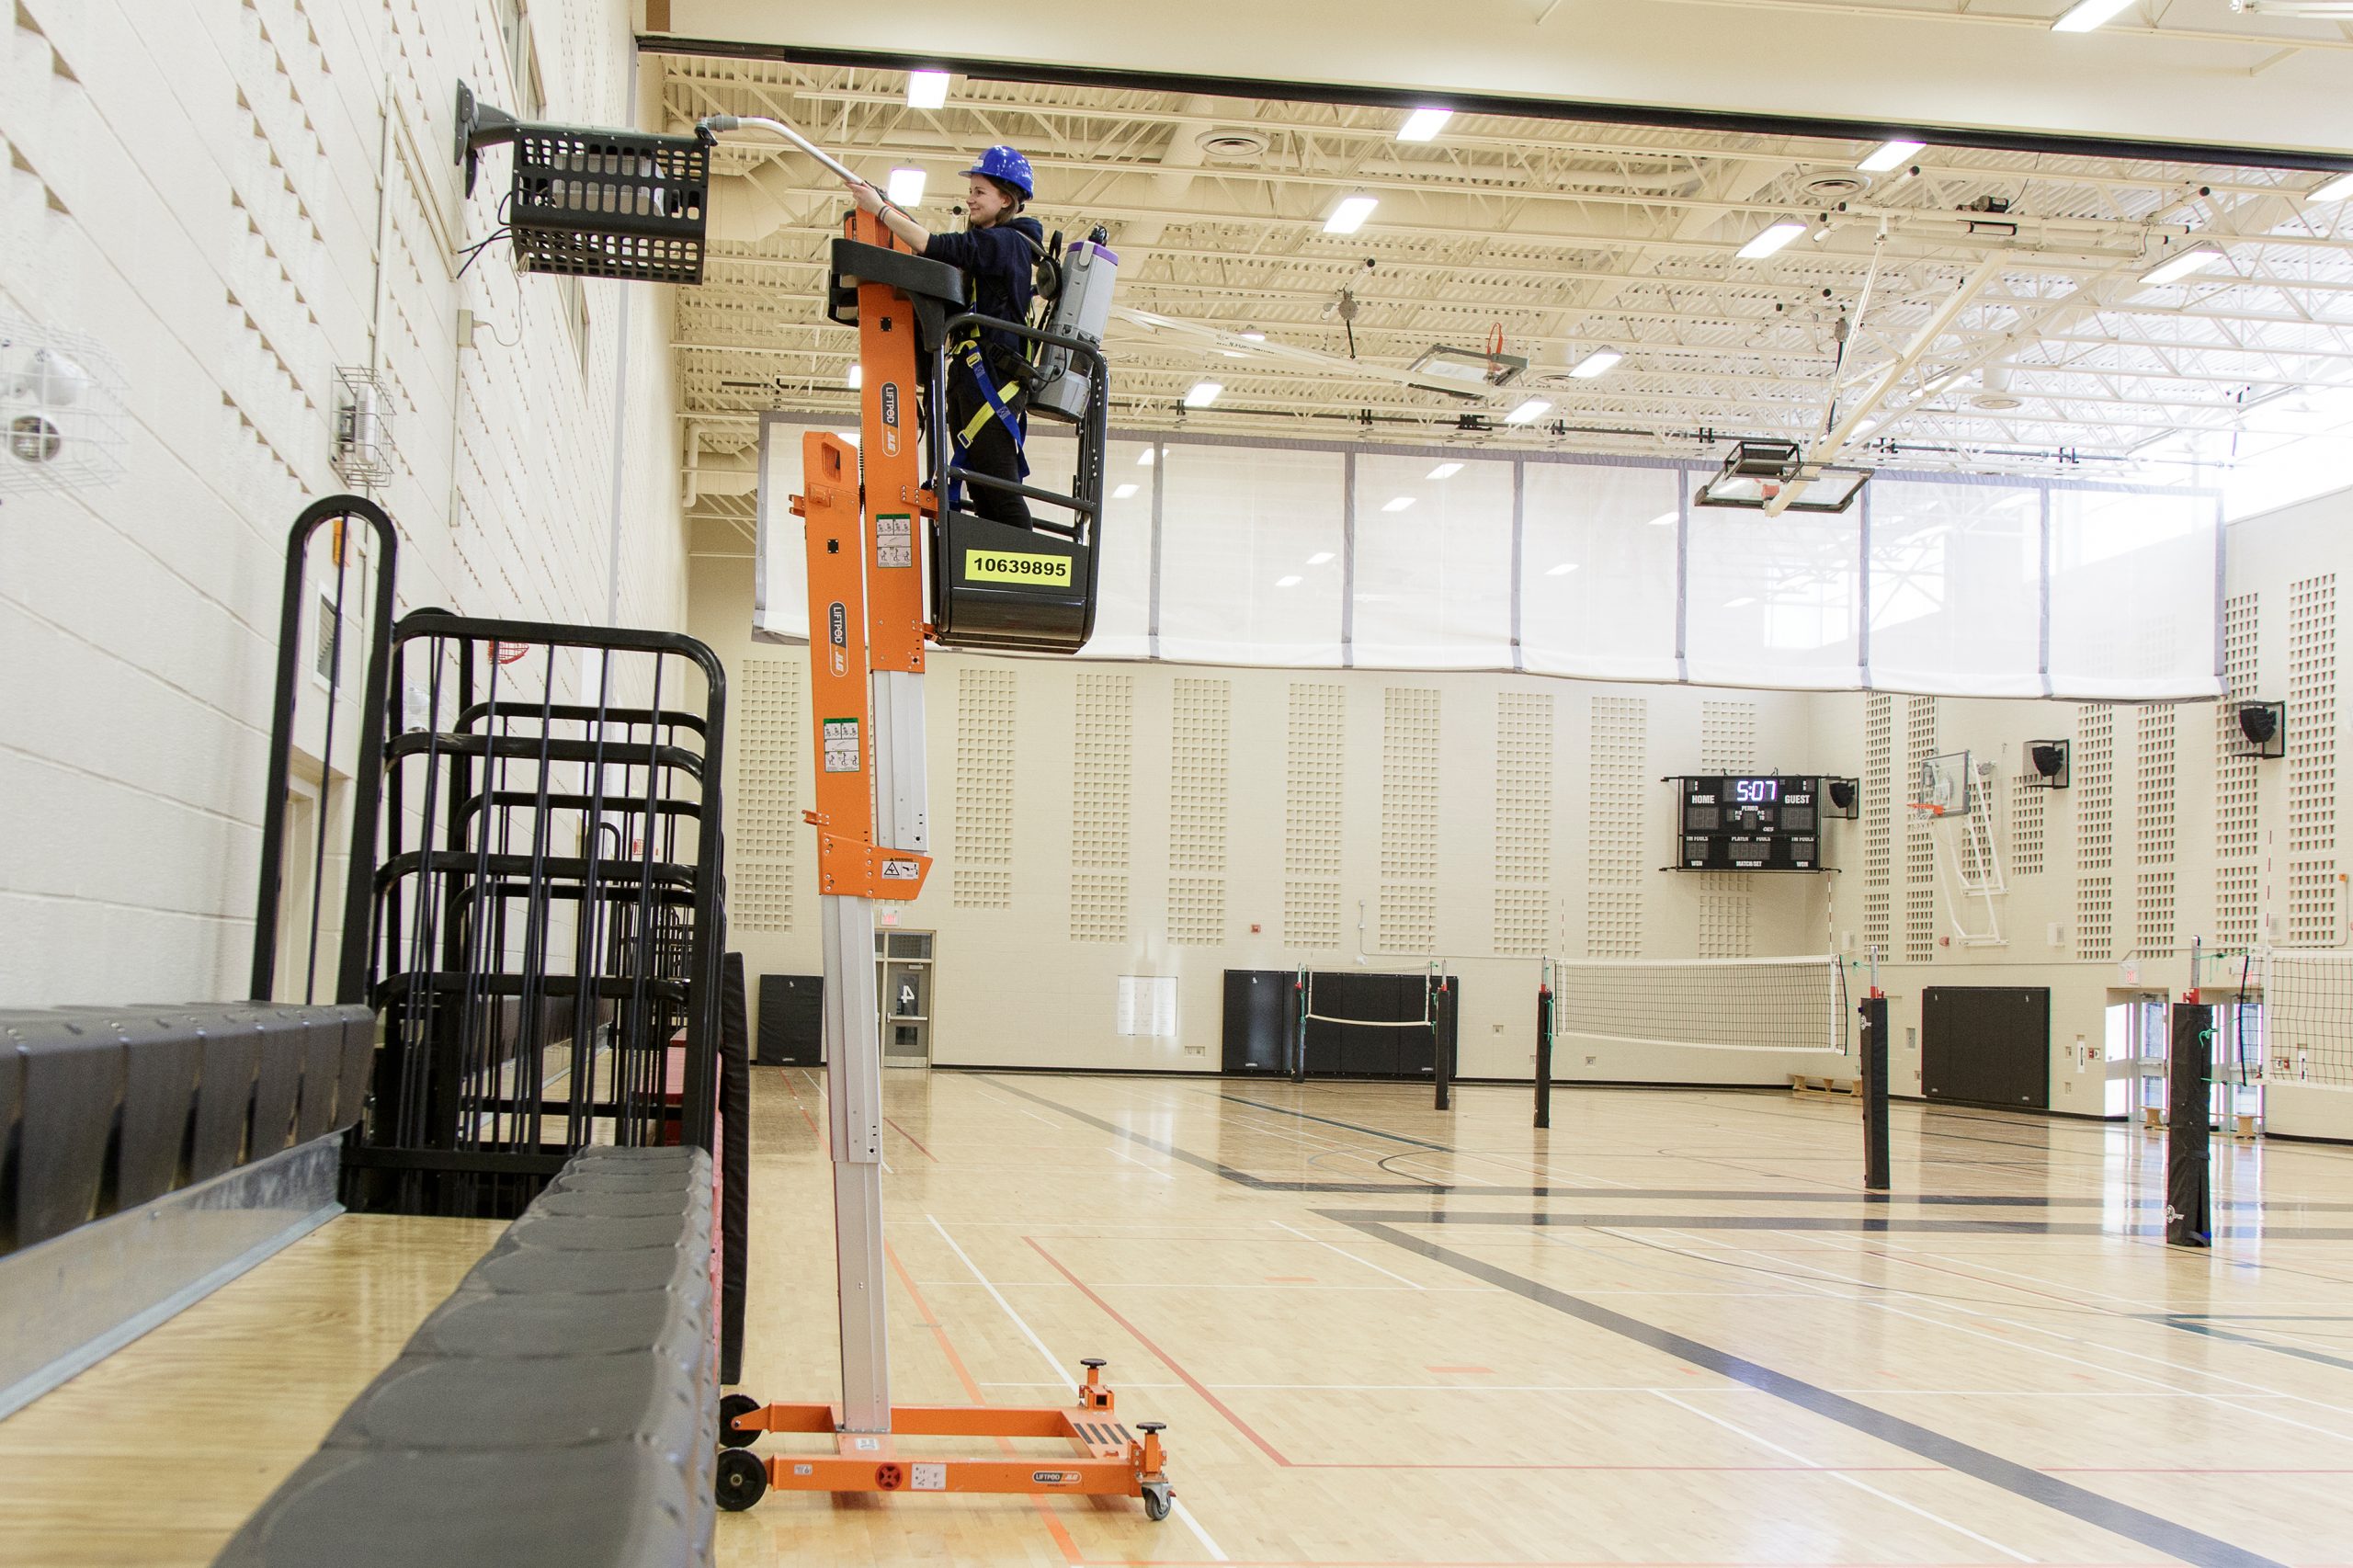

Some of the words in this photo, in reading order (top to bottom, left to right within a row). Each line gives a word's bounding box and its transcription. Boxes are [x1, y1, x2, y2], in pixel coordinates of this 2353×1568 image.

[886, 387, 895, 423] LIFTPOD
[974, 557, 1066, 576] 10639895
[834, 607, 843, 643] LIFTPOD
[1691, 794, 1715, 804] HOME
[1737, 780, 1777, 801] 5:07
[1784, 794, 1811, 804] GUEST
